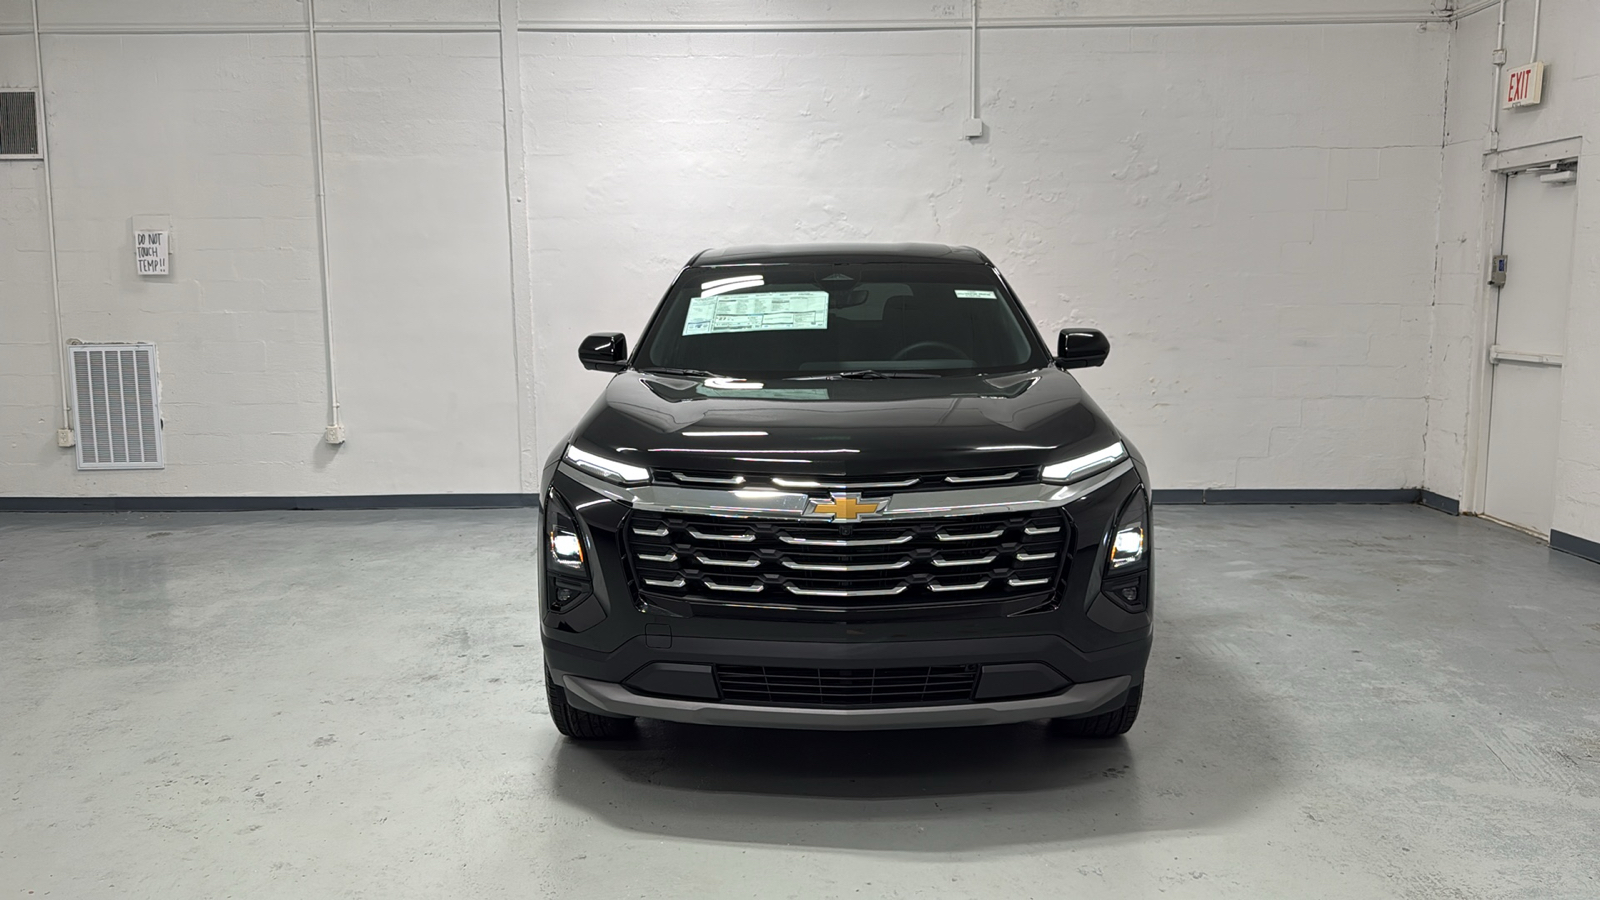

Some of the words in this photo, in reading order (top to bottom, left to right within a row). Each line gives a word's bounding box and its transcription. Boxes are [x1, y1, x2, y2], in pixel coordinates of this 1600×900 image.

[1508, 69, 1531, 102] EXIT
[137, 233, 146, 245] DO
[148, 233, 163, 245] NOT
[137, 246, 158, 258] TOUCH
[138, 258, 166, 272] TEMP!!
